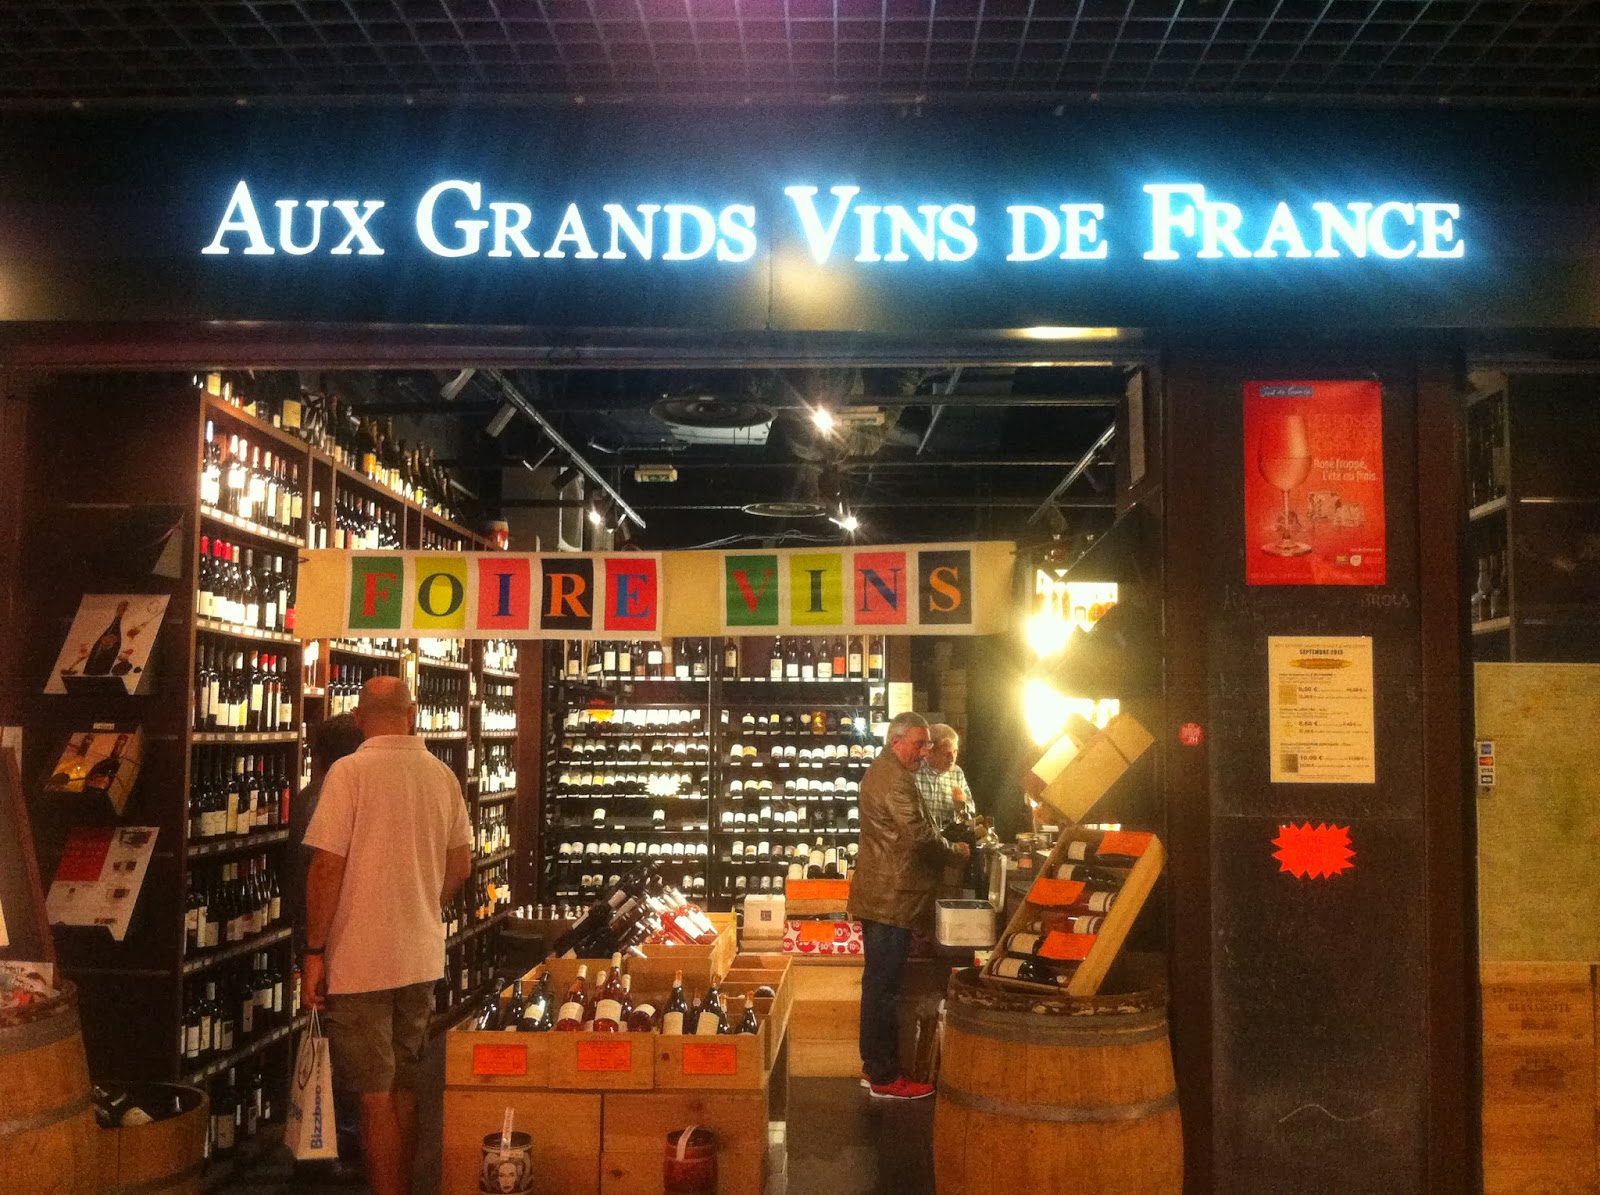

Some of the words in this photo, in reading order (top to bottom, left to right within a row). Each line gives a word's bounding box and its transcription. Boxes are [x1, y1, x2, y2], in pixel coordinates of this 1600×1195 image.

[201, 180, 385, 255] AUX
[416, 180, 757, 261] GRANDS
[784, 184, 978, 264] VINS
[1006, 203, 1108, 261] DE
[1143, 183, 1465, 261] FRANCE
[360, 572, 651, 618] FOIRE
[731, 566, 962, 613] VINS
